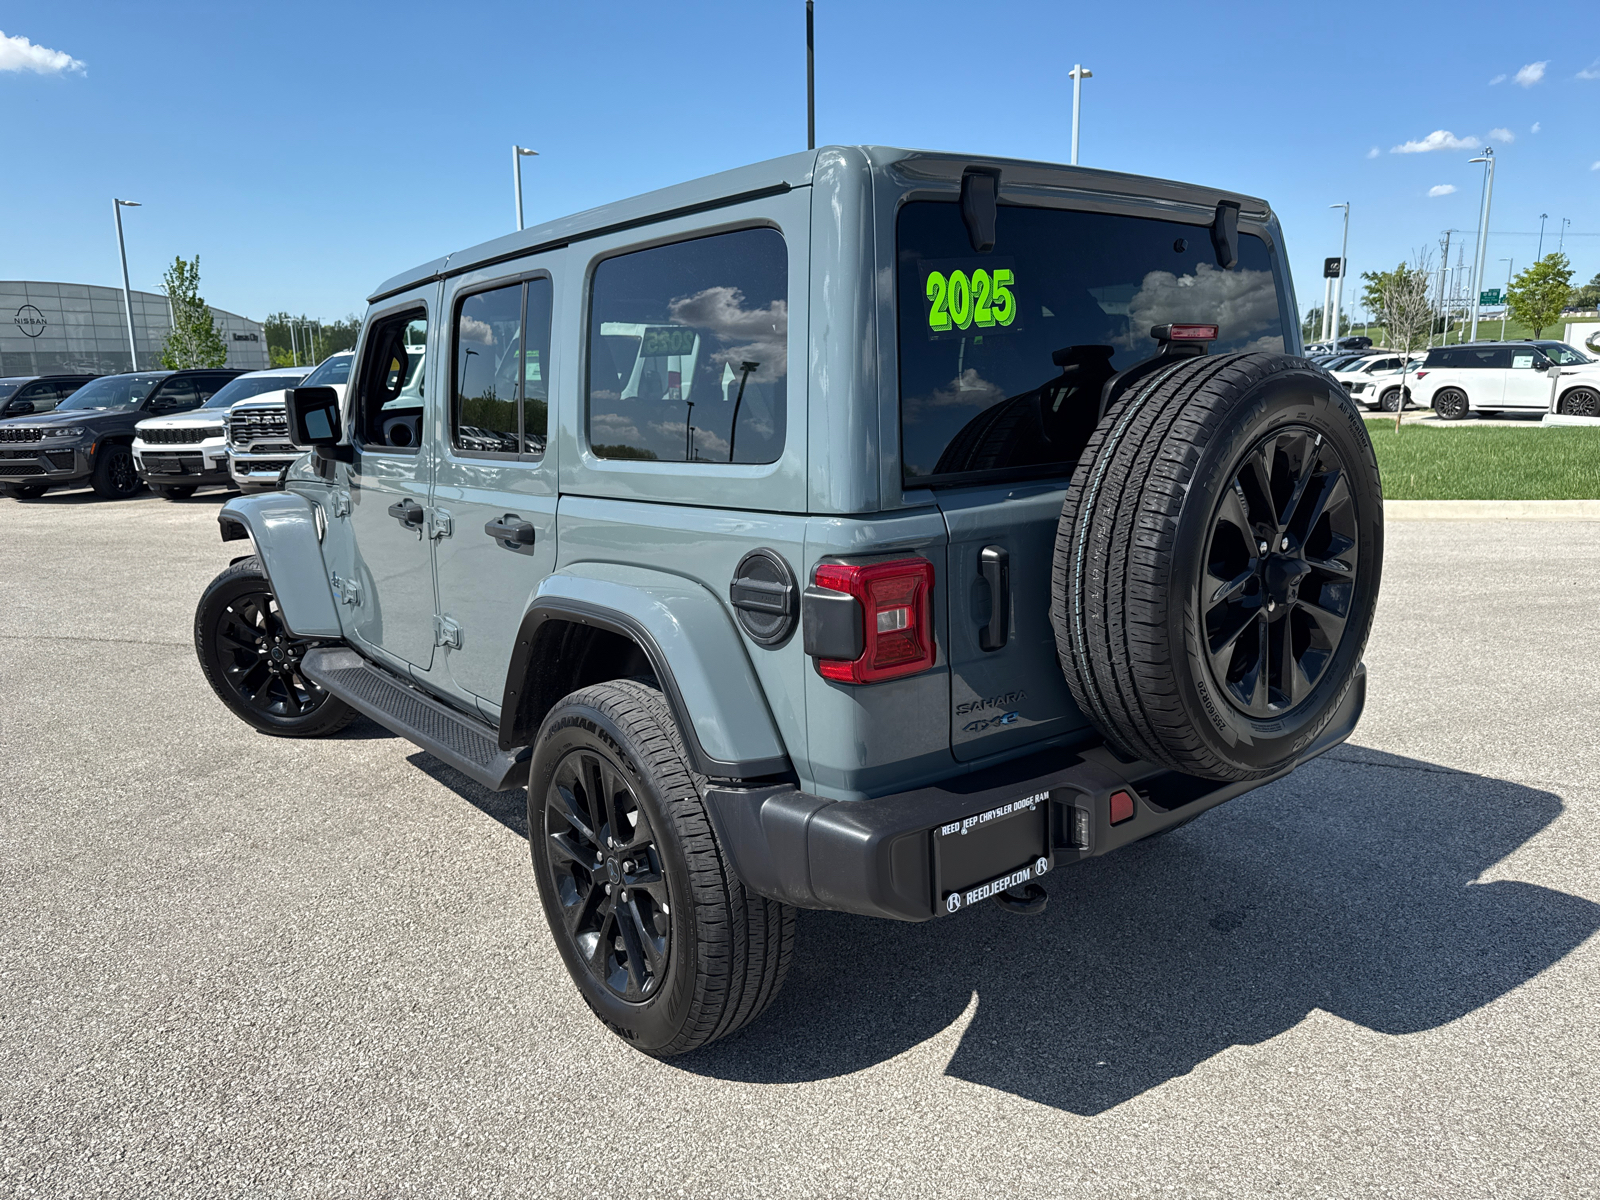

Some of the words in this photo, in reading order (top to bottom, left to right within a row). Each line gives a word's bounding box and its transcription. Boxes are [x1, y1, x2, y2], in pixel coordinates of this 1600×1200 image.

[14, 317, 48, 325] NISSAN
[926, 268, 1017, 332] 2025
[246, 415, 288, 425] RAM
[1338, 402, 1369, 448] All-Weather
[1203, 397, 1268, 494] NEXEN
[956, 689, 1028, 716] SAHARA
[1197, 681, 1226, 731] 255/60R20
[941, 822, 960, 836] REED
[963, 816, 978, 828] JEEP
[979, 804, 1012, 823] CHRYSLER
[1013, 796, 1034, 811] DODGE
[1034, 791, 1050, 804] RAM
[966, 868, 1031, 906] REEDJEEP.COM
